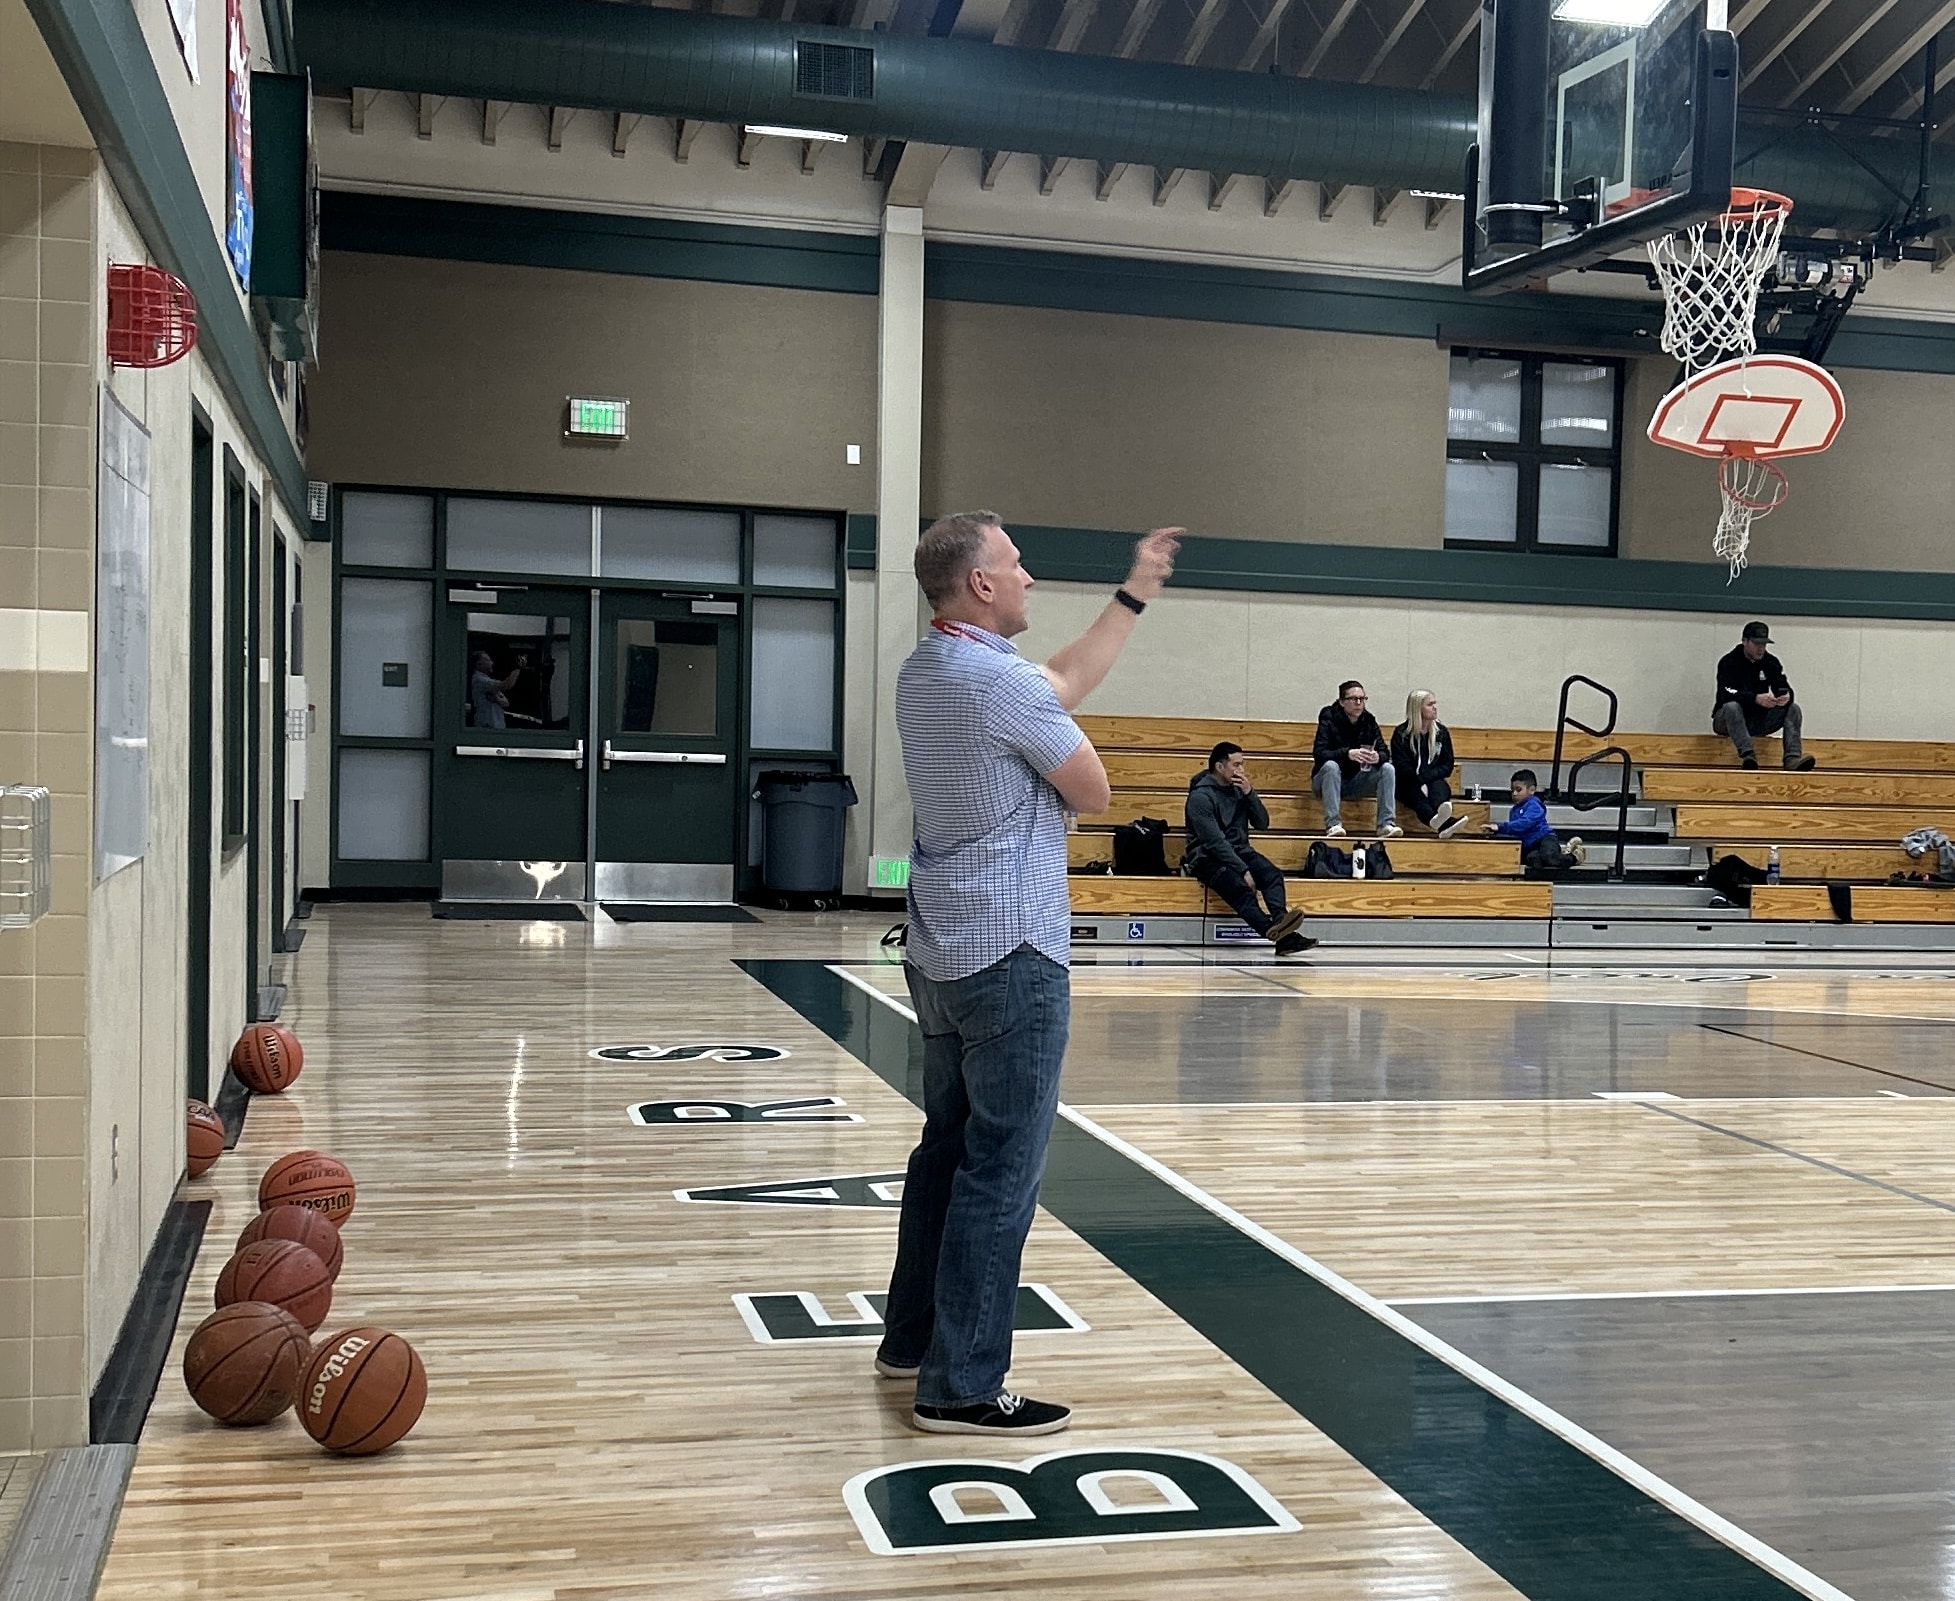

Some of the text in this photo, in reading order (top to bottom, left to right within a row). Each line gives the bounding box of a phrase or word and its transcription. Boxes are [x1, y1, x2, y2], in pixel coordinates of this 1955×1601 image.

[877, 860, 910, 885] EXIT
[263, 1034, 282, 1079] Wilson
[588, 1043, 1303, 1555] BEARS
[309, 1336, 371, 1414] Wilson
